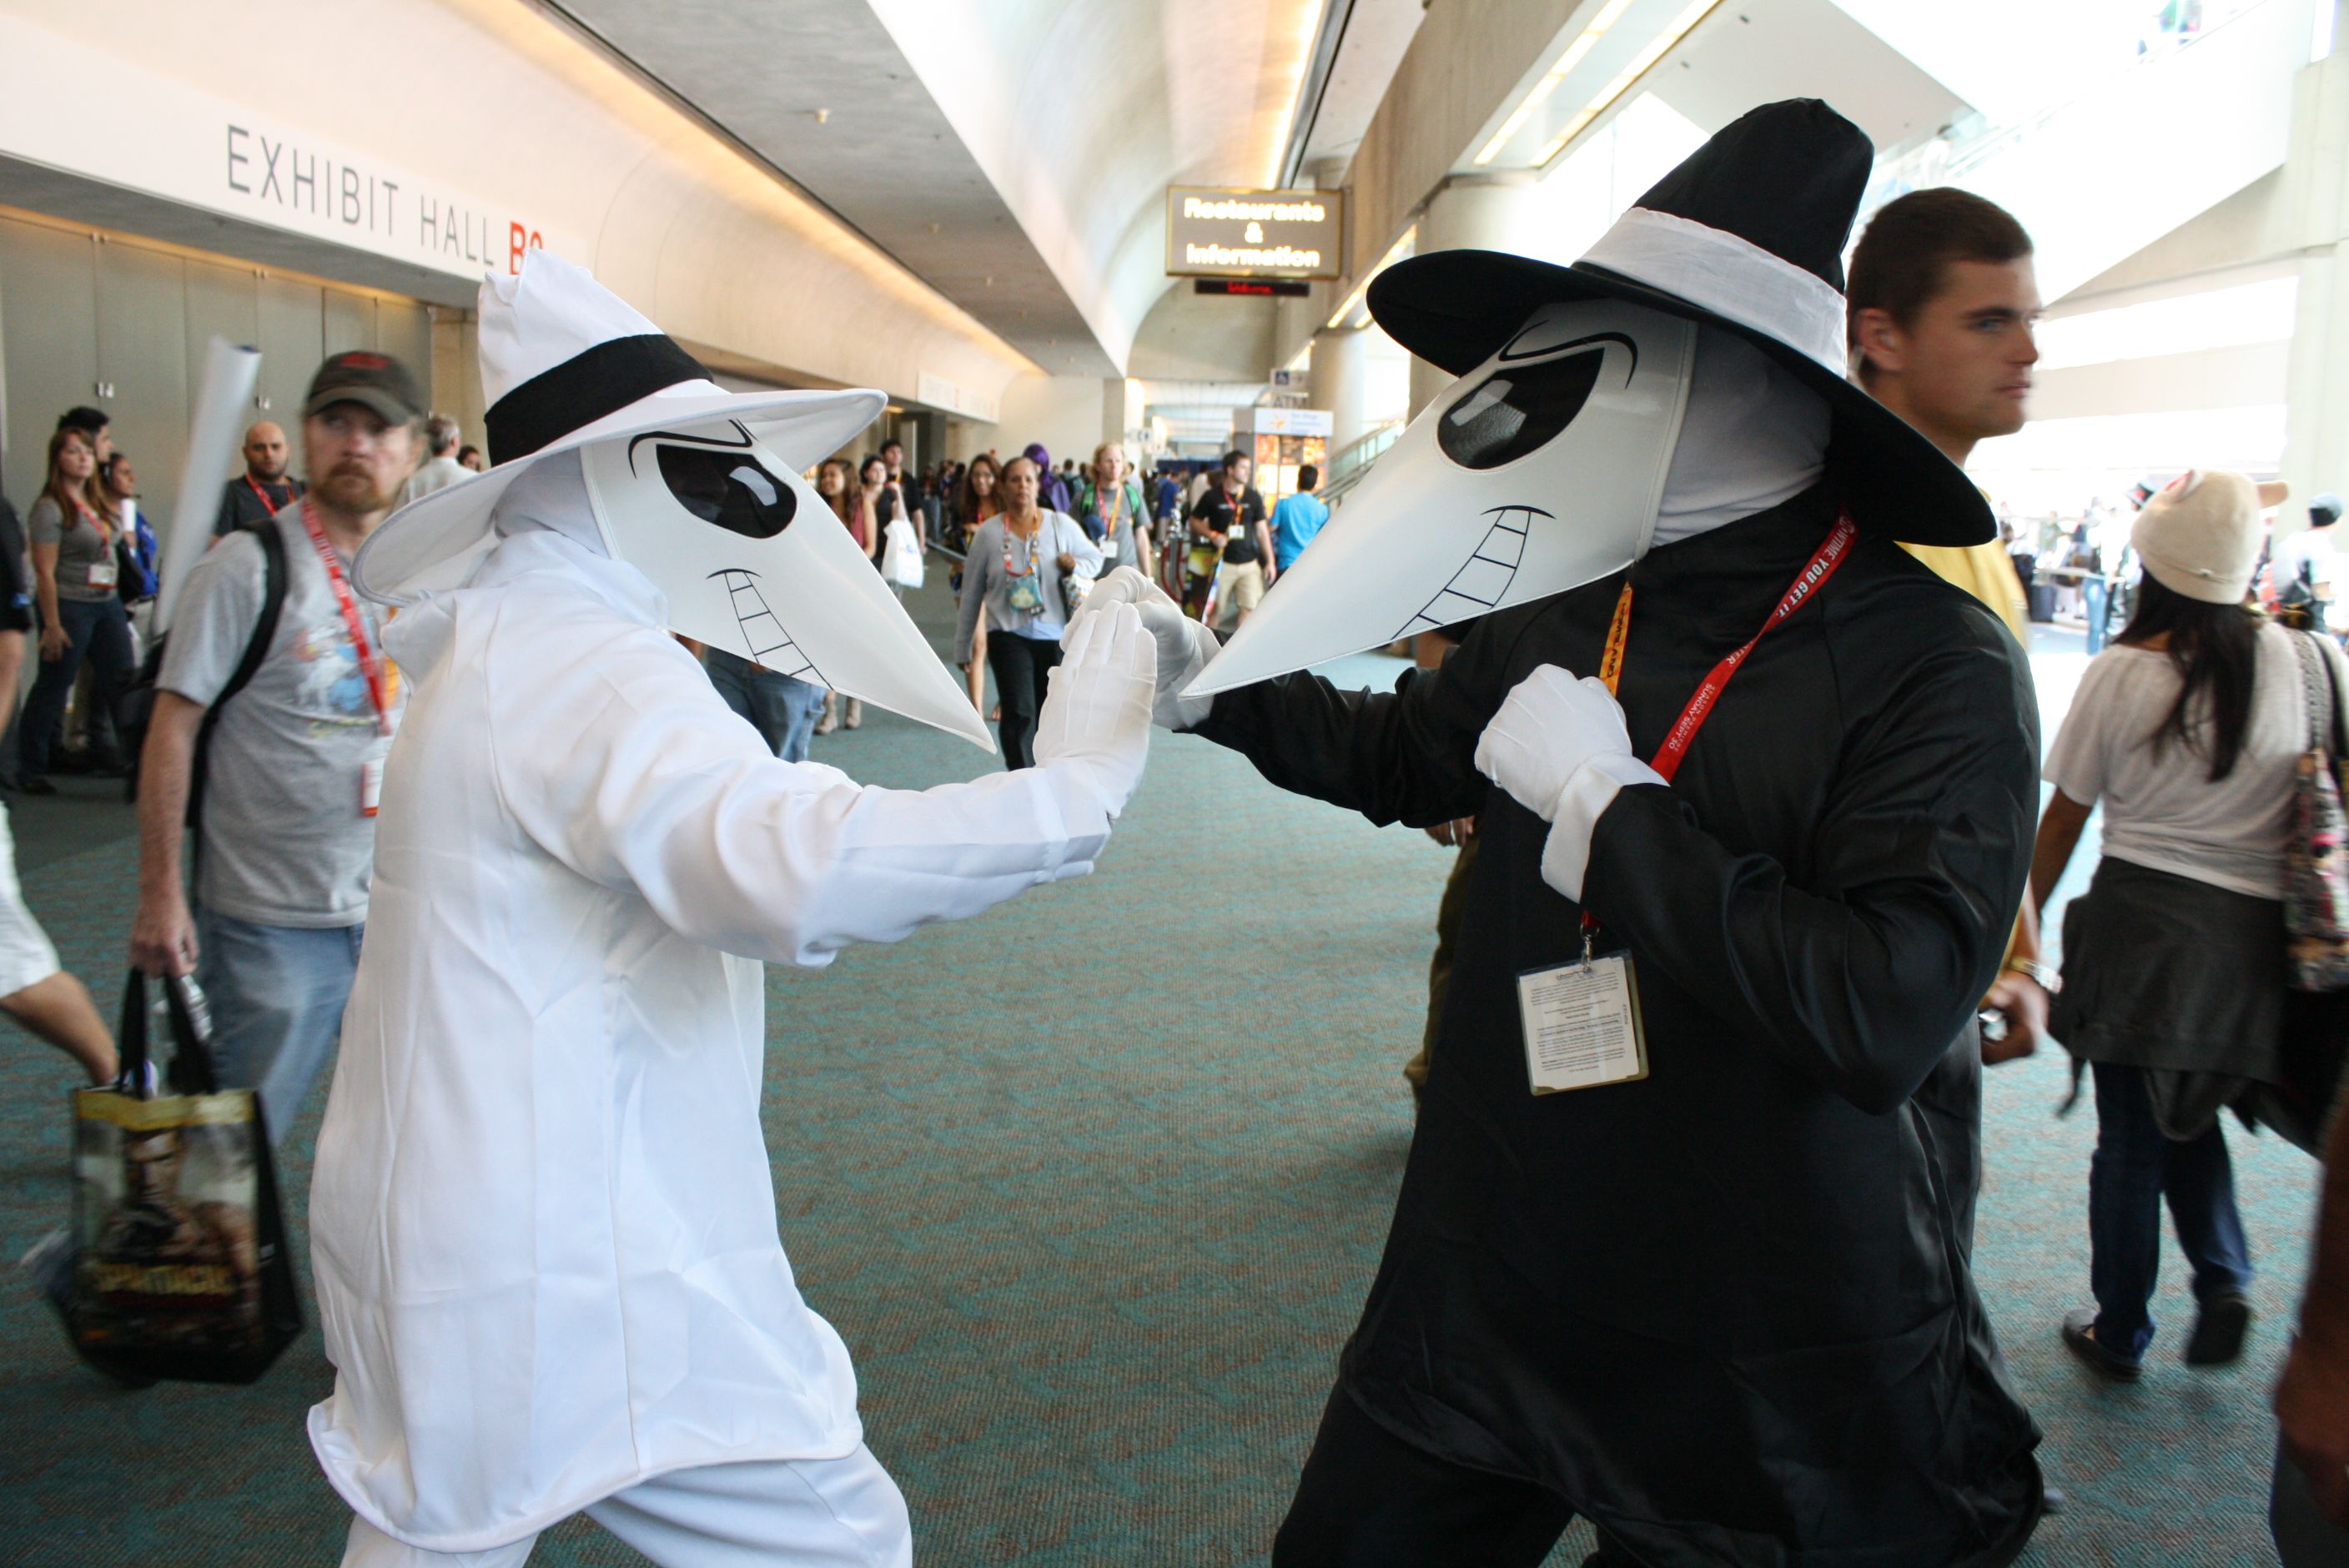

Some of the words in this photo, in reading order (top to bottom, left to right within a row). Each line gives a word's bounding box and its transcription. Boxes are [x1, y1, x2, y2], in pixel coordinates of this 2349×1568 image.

[227, 123, 399, 237] EXHIBIT
[420, 194, 494, 266] HALL
[1184, 197, 1325, 222] Restaurants
[1244, 221, 1264, 244] &
[1186, 244, 1320, 268] Information
[1806, 558, 1829, 584] YOU
[1789, 580, 1809, 606] GET
[1688, 682, 1713, 716] SUNDAY
[1676, 716, 1691, 738] SEPT
[1668, 736, 1678, 749] 30
